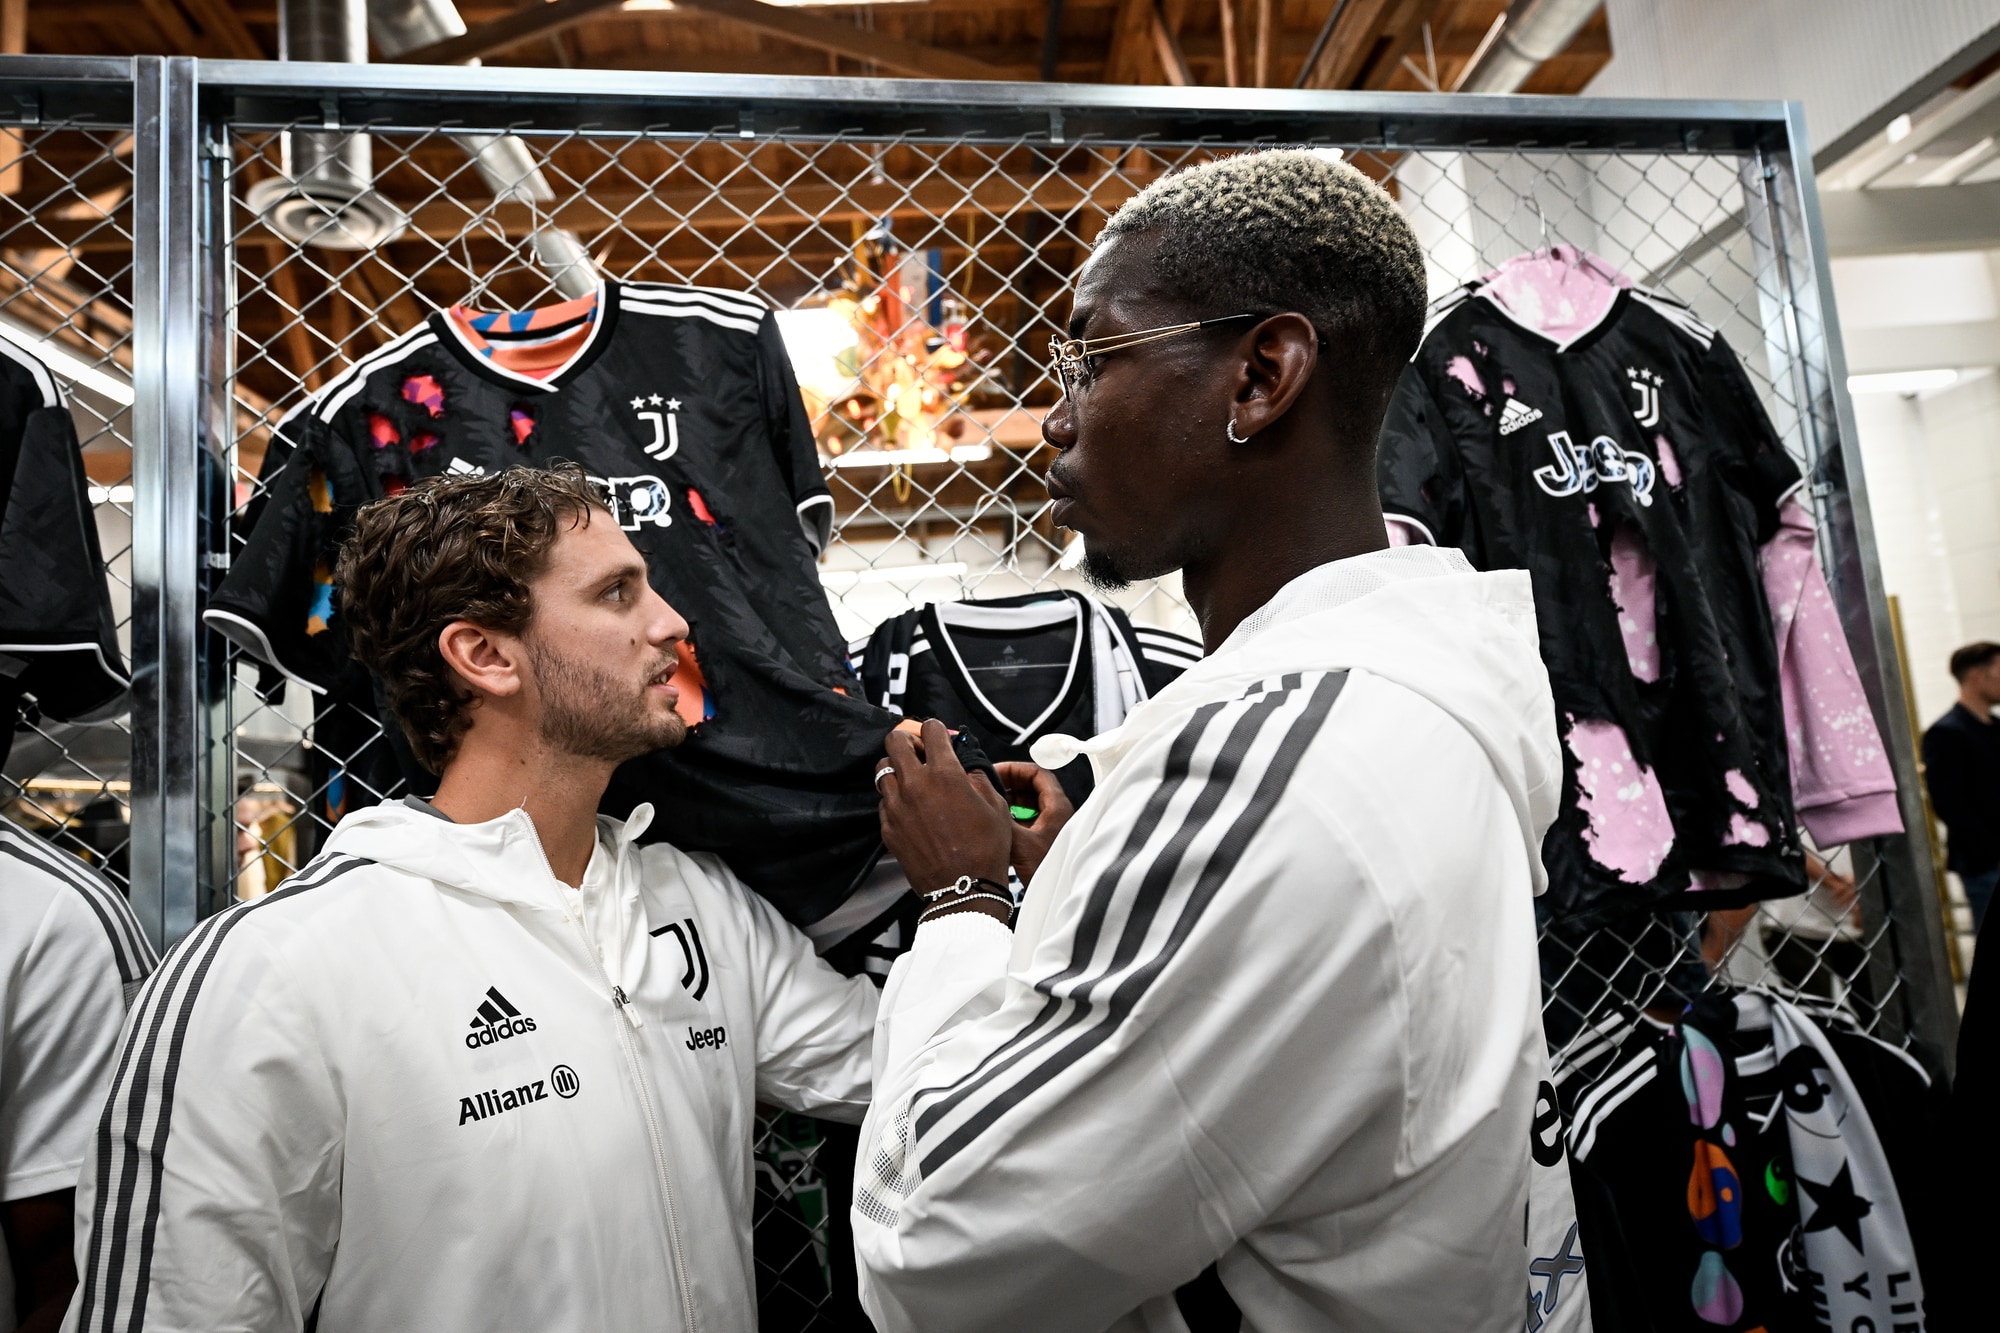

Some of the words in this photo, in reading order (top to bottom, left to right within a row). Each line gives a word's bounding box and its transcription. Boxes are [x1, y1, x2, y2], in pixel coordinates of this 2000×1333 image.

[1499, 408, 1543, 436] adidas
[465, 1016, 537, 1049] adidas
[685, 1026, 727, 1050] Jeep
[458, 1079, 549, 1126] Allianz
